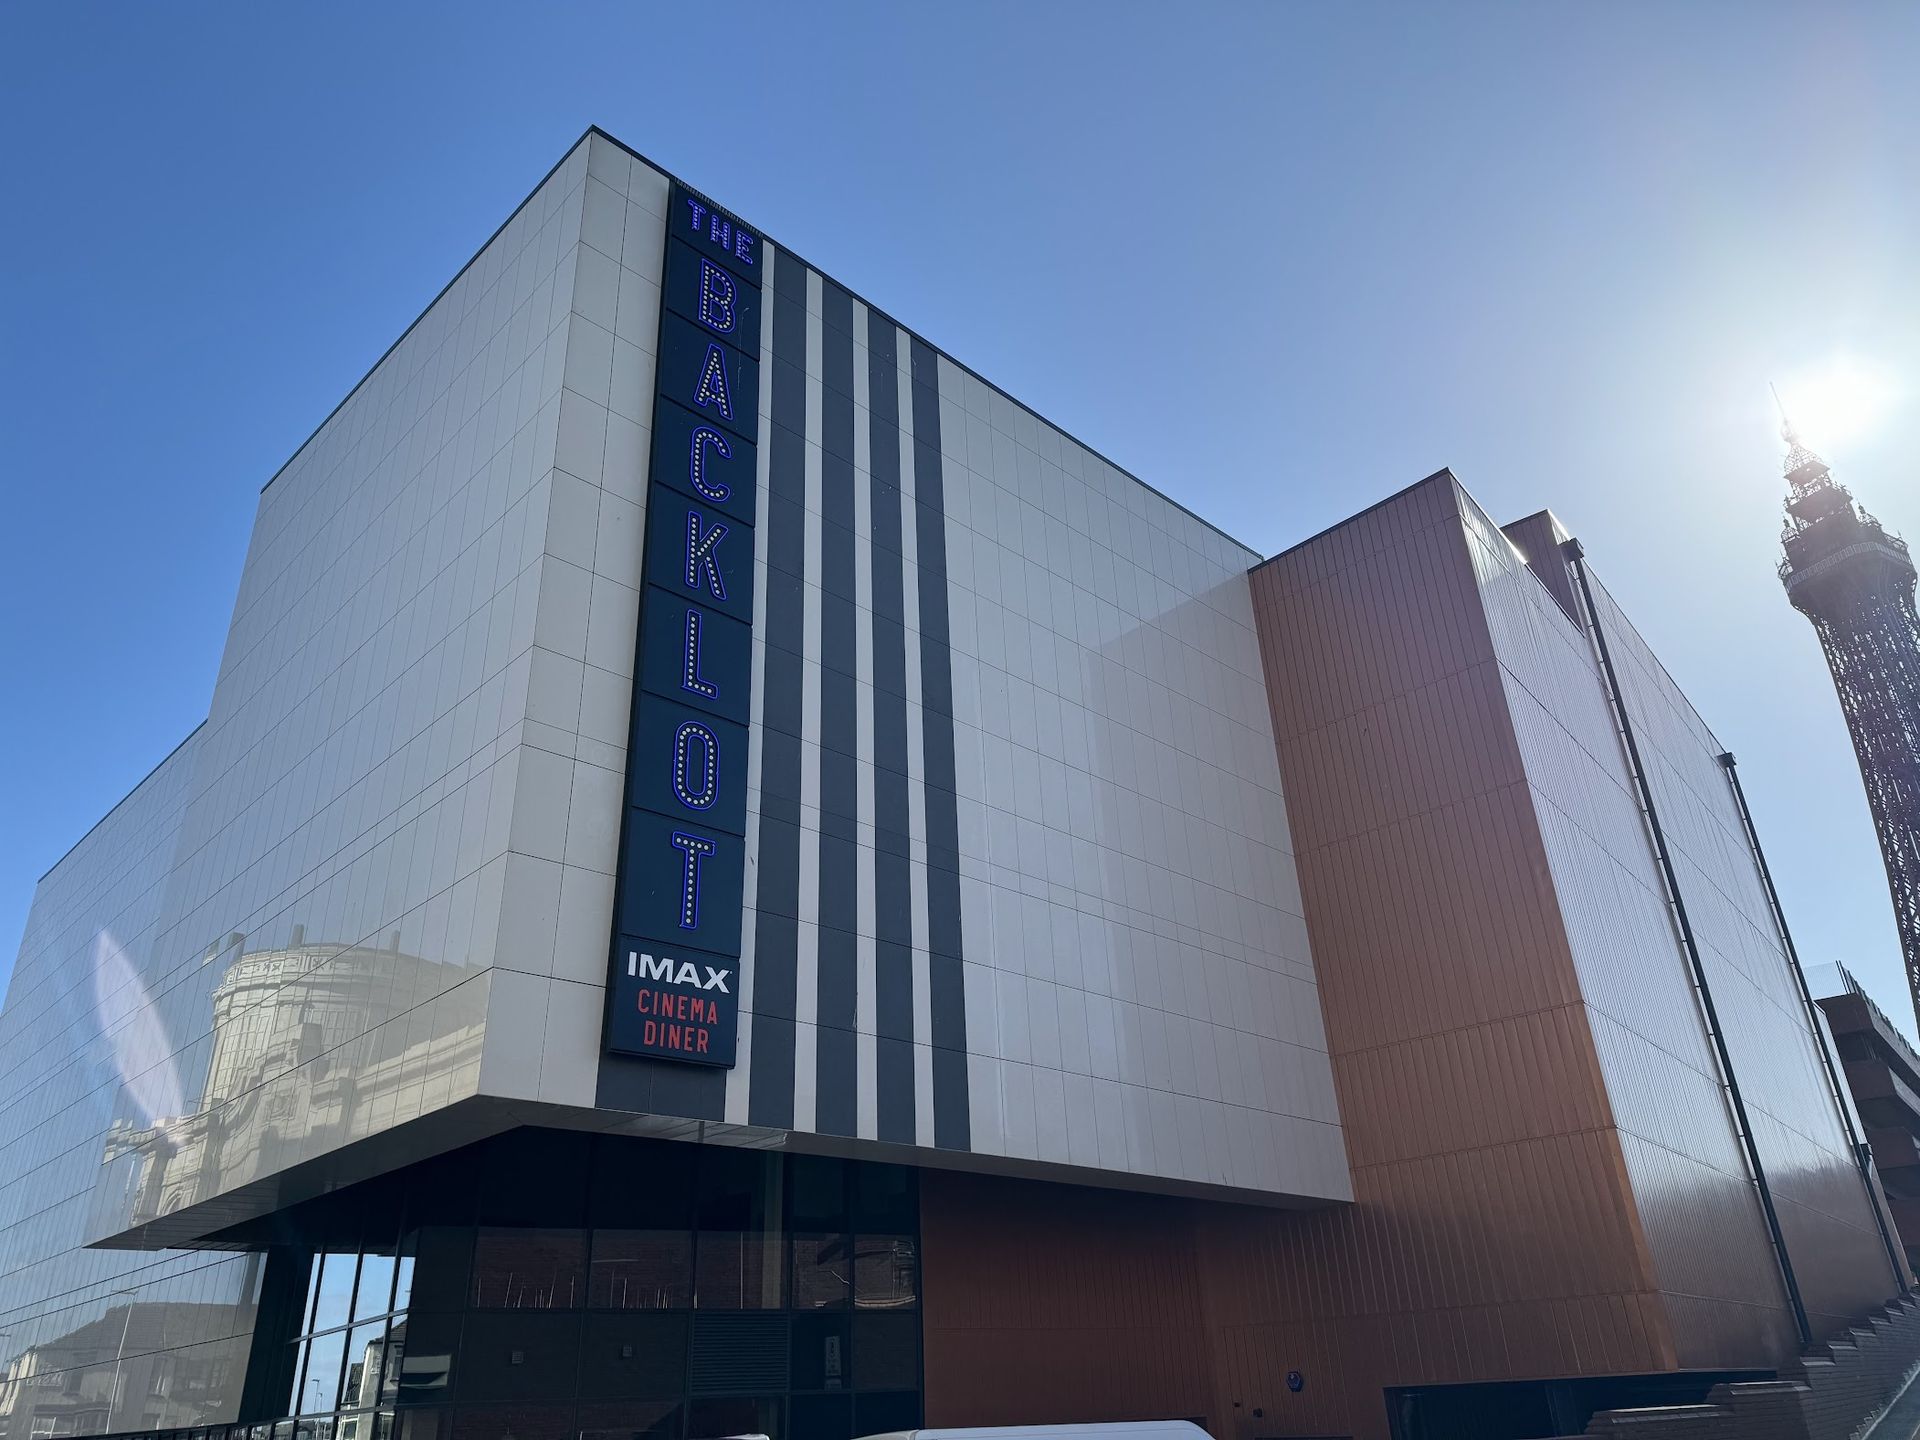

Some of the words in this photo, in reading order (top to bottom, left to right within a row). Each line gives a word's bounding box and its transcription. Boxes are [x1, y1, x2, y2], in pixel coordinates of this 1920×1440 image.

[687, 199, 754, 264] THE
[672, 258, 736, 930] BACKLOT
[627, 951, 732, 994] IMAX
[637, 988, 718, 1025] CINEMA
[643, 1020, 708, 1054] DINER
